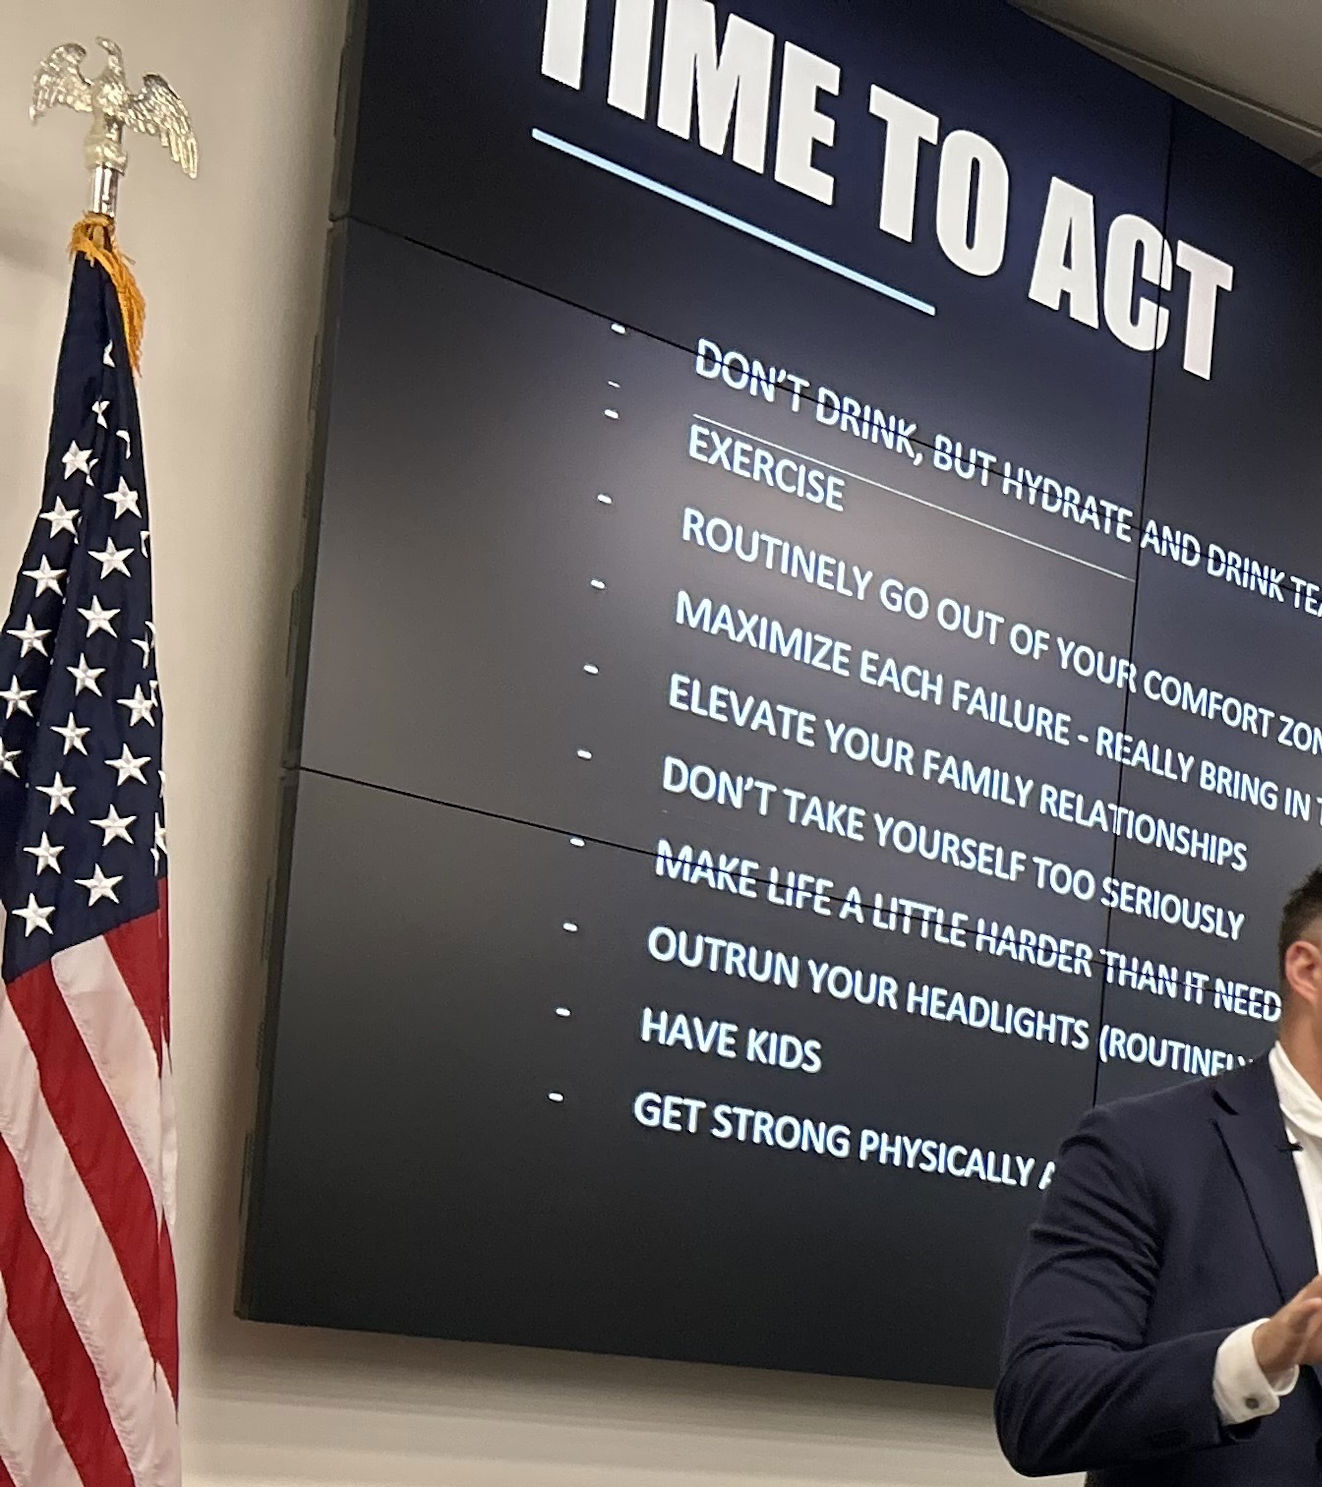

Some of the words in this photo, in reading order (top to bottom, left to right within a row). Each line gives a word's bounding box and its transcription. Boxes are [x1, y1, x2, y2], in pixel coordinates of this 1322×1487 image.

[868, 83, 1010, 277] TO
[1027, 176, 1234, 381] ACT
[689, 423, 845, 512] EXERCISE
[695, 337, 811, 412] DON'T
[815, 386, 923, 466] DRINK,
[933, 433, 997, 487] BUT
[1002, 461, 1134, 543] HYDRATE
[1140, 519, 1201, 567] AND
[1206, 543, 1286, 603] DRINK
[675, 590, 852, 677] MAXIMIZE
[859, 649, 943, 706] EACH
[952, 679, 1072, 746] FAILURE
[1095, 725, 1195, 783] REALLY
[1199, 759, 1279, 811] BRING
[1284, 787, 1311, 822] IN
[682, 507, 873, 601] ROUTINELY
[879, 578, 929, 620] GO
[937, 598, 1005, 645] OUT
[1009, 623, 1050, 660] OF
[1056, 636, 1137, 694] YOUR
[1143, 669, 1276, 738] COMFORT
[662, 755, 778, 816] DON'T
[782, 787, 867, 842] TAKE
[873, 812, 1027, 882] YOURSELF
[1032, 856, 1096, 901] TOO
[1100, 876, 1245, 941] SERIOUSLY
[669, 673, 817, 748] ELEVATE
[824, 718, 914, 776] YOUR
[922, 748, 1034, 808] FAMILY
[1039, 783, 1248, 872] RELATIONSHIPS
[647, 926, 800, 989] OUTRUN
[807, 959, 899, 1011] YOUR
[906, 981, 1090, 1051] HEADLIGHTS
[655, 839, 760, 899] MAKE
[767, 866, 834, 916] LIFE
[838, 886, 865, 924] A
[872, 893, 969, 949] LITTLE
[975, 917, 1094, 978] HARDER
[1098, 948, 1179, 999] THAN
[1183, 970, 1210, 1005] IT
[1213, 977, 1282, 1022] NEED
[640, 1006, 739, 1059] HAVE
[746, 1027, 822, 1074] KIDS
[633, 1091, 707, 1134] GET
[710, 1104, 851, 1159] STRONG
[859, 1128, 1036, 1187] PHYSICALLY
